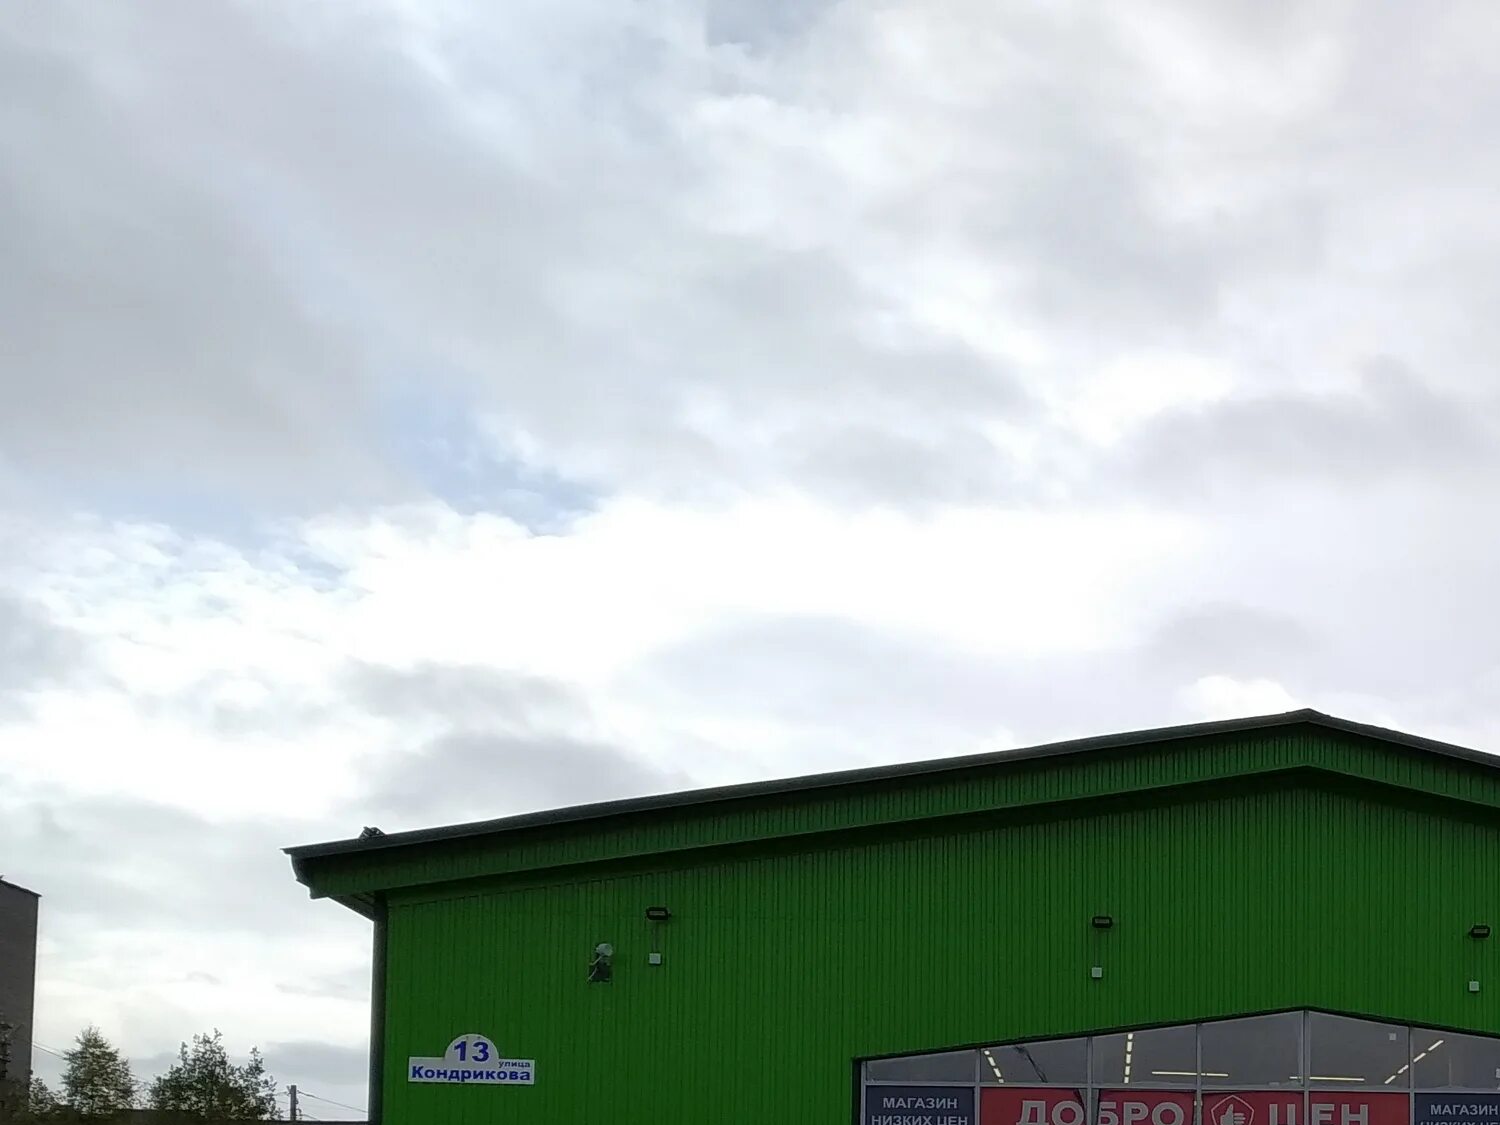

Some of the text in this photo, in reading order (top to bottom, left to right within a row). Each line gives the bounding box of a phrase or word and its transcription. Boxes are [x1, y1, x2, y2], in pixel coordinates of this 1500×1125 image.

[454, 1041, 489, 1062] 13
[498, 1061, 531, 1069] улица
[411, 1065, 531, 1082] Кондрикова
[882, 1097, 958, 1109] МАГАЗИН
[1430, 1104, 1499, 1116] МАГАЗИН
